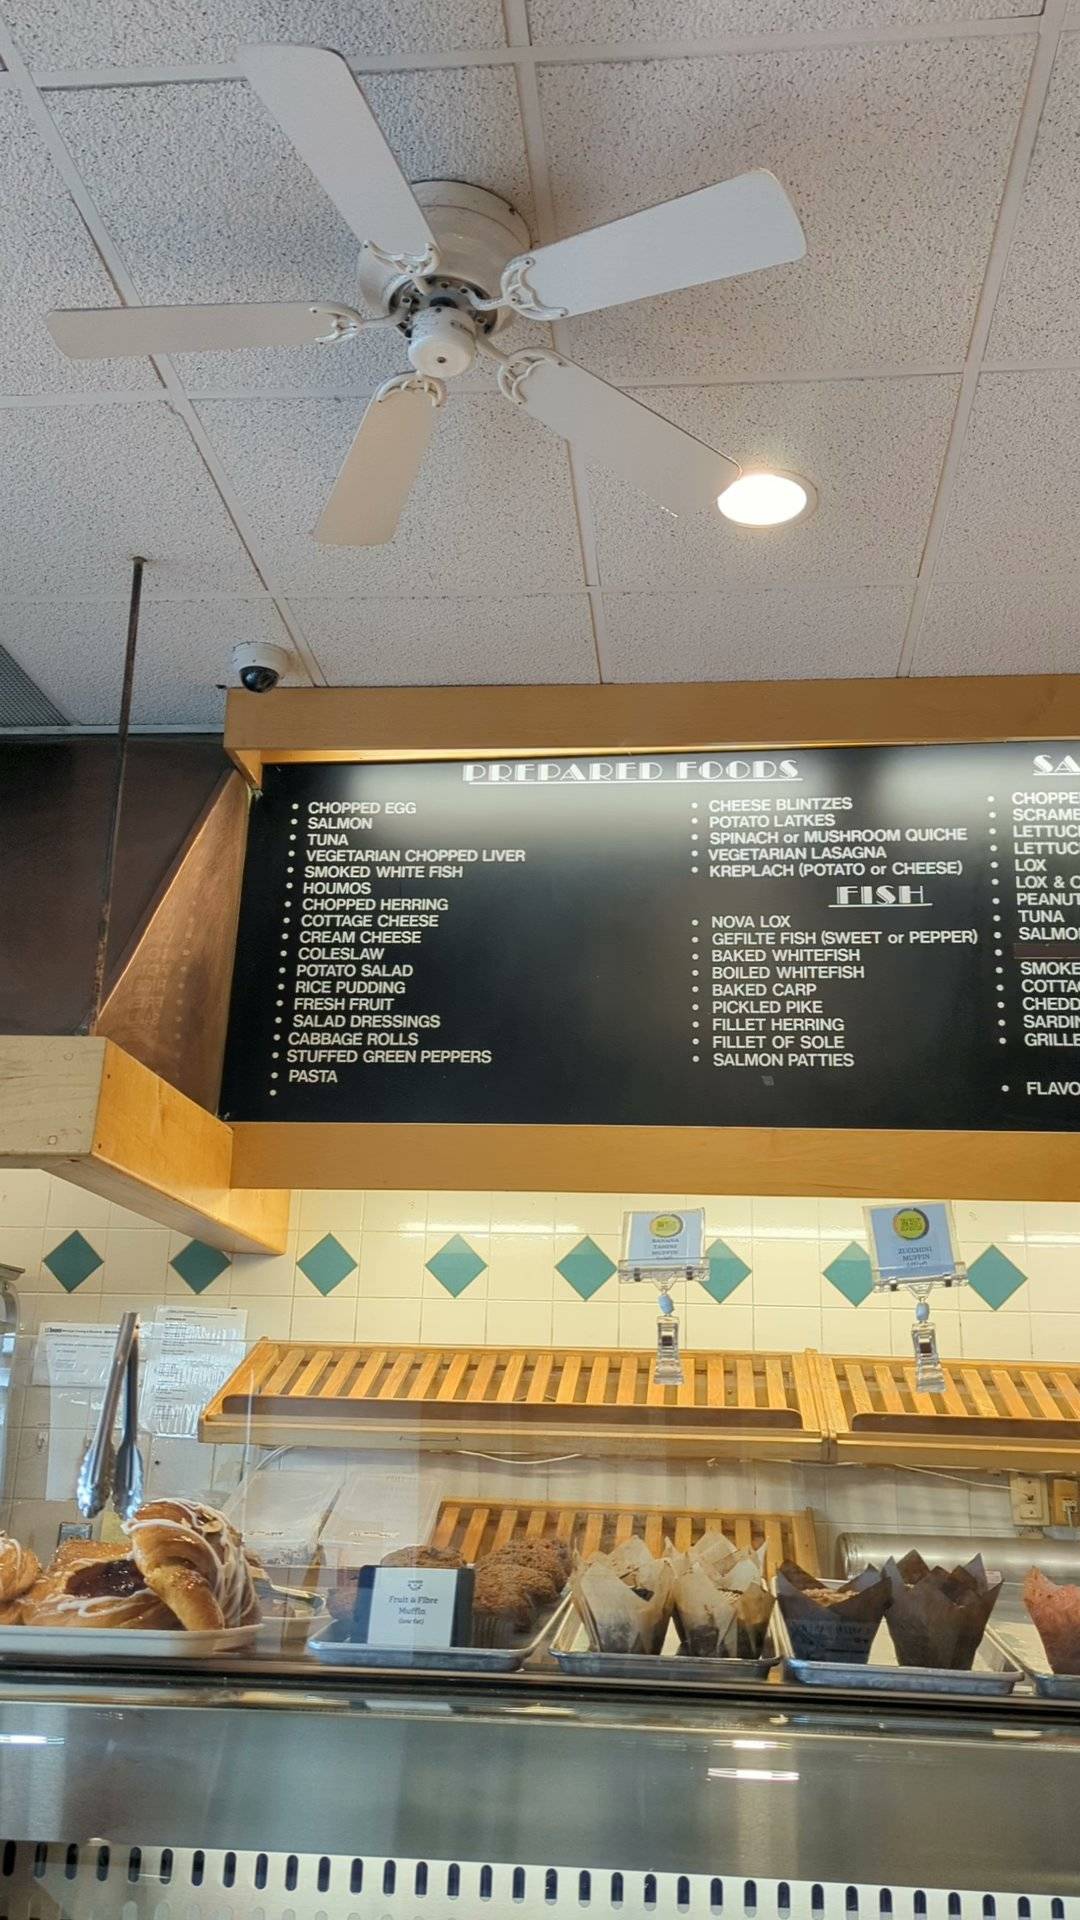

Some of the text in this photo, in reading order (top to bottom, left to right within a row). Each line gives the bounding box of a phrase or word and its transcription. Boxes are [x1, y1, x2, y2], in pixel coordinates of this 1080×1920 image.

[463, 760, 799, 781] PREPARED FOODS
[308, 802, 416, 814] CHOPPED EGG
[709, 797, 853, 812] CHEESE BLINTZES
[308, 817, 371, 829] SALMON
[710, 814, 835, 828] POTATO LATKES
[710, 828, 968, 844] SPINACH or MUSHROOM QUICHE
[1013, 825, 1080, 837] LETTUC
[307, 834, 348, 846] TUNA
[306, 850, 525, 862] VEGETARIAN CHOPPED LIVER
[708, 846, 887, 861] VEGETARIAN LASAGNA
[710, 861, 962, 877] KREPLACH (POTATO or CHEESE)
[1015, 859, 1046, 871] LOX
[305, 866, 463, 878] SMOKED WHITE FISH
[303, 882, 371, 894] HOUMOS
[1016, 876, 1048, 888] LOX
[1054, 876, 1065, 888] &
[836, 885, 925, 905] FISH
[303, 898, 448, 910] CHOPPED HERRING
[301, 915, 438, 927] COTTAGE CHEESE
[712, 915, 791, 928] NOVA LOX
[1018, 910, 1065, 923] TUNA
[300, 931, 421, 943] CREAM CHEESE
[712, 929, 977, 945] GEFILTE FISH (SWEET or PEPPER)
[1019, 927, 1080, 940] SALMO
[298, 947, 384, 960] COLESLAW
[712, 949, 860, 962] BAKED WHITEFISH
[297, 964, 413, 977] POTATO SALAD
[712, 966, 864, 979] BOILED WHITEFISH
[296, 981, 405, 993] RICE PUDDING
[712, 983, 816, 996] BAKED CARP
[1022, 979, 1080, 992] COTTA
[294, 998, 394, 1010] FRESH FRUIT
[713, 1001, 823, 1013] PICKLED PIKE
[1023, 997, 1080, 1010] CHEDD
[293, 1015, 440, 1028] SALAD DRESSINGS
[713, 1018, 844, 1031] FILLET HERRING
[1024, 1015, 1080, 1028] SARDI
[288, 1032, 418, 1045] CABBAGE ROLLS
[713, 1036, 844, 1049] FILLET OF SOLE
[287, 1050, 491, 1063] STUFFED GREEN PEPPERS
[714, 1053, 854, 1066] SALMON PATTIES
[289, 1070, 337, 1082] PASTA
[1027, 1082, 1080, 1095] FLAVO
[389, 1596, 409, 1604] Fruit
[418, 1596, 438, 1604] Fibre
